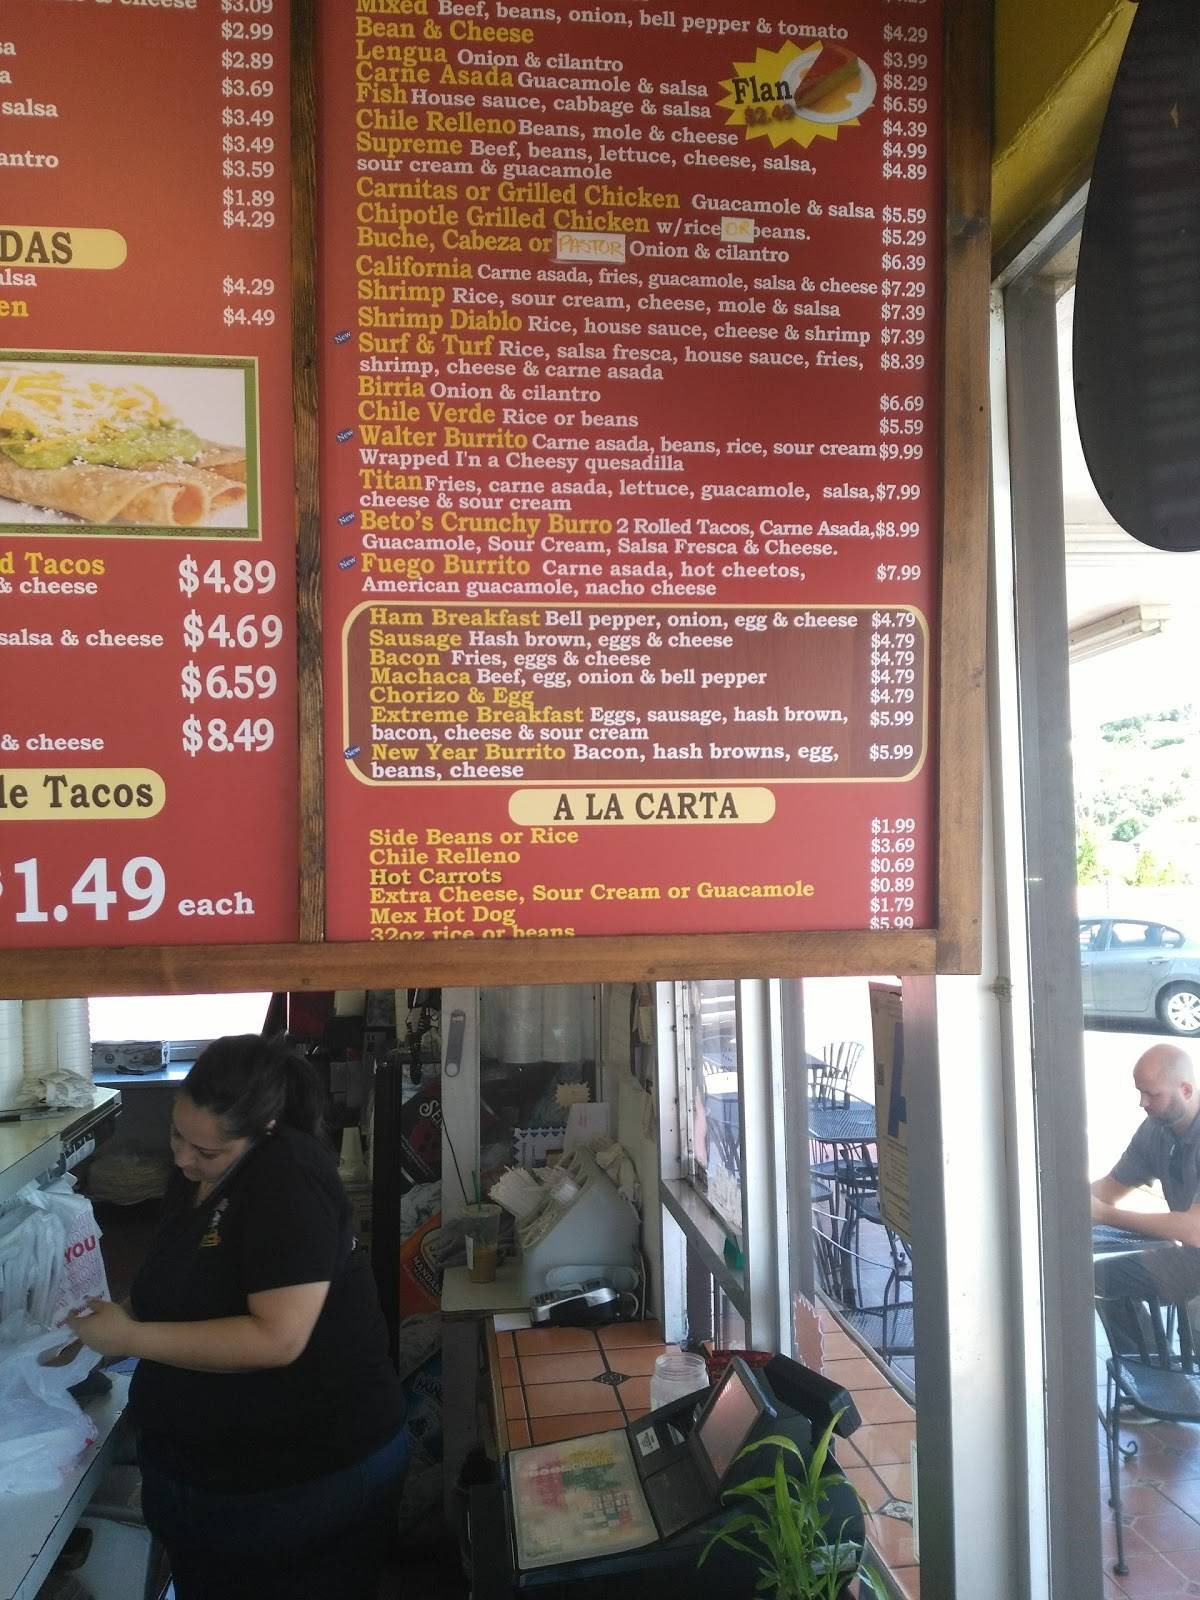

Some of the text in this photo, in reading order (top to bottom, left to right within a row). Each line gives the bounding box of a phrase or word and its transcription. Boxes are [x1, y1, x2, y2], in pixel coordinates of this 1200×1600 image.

[221, 20, 273, 40] $2.99
[355, 16, 534, 43] Bean & Cheese
[221, 49, 273, 70] $2.89
[883, 50, 927, 68] $3.99
[221, 77, 274, 97] $3.69
[732, 77, 792, 104] Flan
[2, 98, 59, 118] salsa
[221, 107, 274, 127] $3.49
[356, 108, 738, 145] Chile Relleno Beans, mole & cheese
[222, 134, 274, 154] $3.49
[882, 140, 927, 159] $4.99
[223, 158, 274, 178] $3.59
[223, 187, 275, 207] $1.89
[356, 177, 875, 219] Carnitas or Grilled Chicken Guacamole & salsa
[223, 208, 275, 229] $4.29
[356, 202, 458, 233] Chipotle
[467, 206, 546, 228] Grilled
[553, 209, 649, 232] Chicken
[656, 218, 721, 237] w/rice
[882, 206, 926, 224] $5.59
[358, 227, 789, 262] Buche, Cabeza or PASTOR Onion & cilantro
[882, 227, 926, 246] $5.29
[881, 252, 926, 271] $6.39
[223, 276, 274, 296] $4.29
[223, 306, 275, 326] $4.49
[358, 376, 601, 402] Birria Onion & cilantro
[880, 393, 924, 412] $6.69
[337, 429, 353, 442] New
[360, 449, 684, 474] Wrapped I'n a Cheesy quesadilla
[338, 512, 355, 525] New
[441, 512, 540, 538] Crunchy
[548, 513, 612, 533] Burro
[616, 519, 629, 533] 2
[634, 518, 691, 534] Rolled
[697, 519, 754, 538] Tacos,
[760, 520, 812, 536] Carne
[817, 521, 875, 539] Asada,
[875, 521, 919, 538] $8.99
[25, 552, 105, 576] Tacos
[339, 556, 357, 569] New
[361, 553, 806, 581] Fuego Burrito Carne asada, hot cheetos,
[877, 563, 921, 581] $7.99
[20, 577, 98, 594] cheese
[179, 554, 276, 598] $4.89
[369, 608, 858, 631] Ham Breakfast Bell pepper, onion, egg & cheese
[871, 611, 915, 629] $4.79
[60, 630, 79, 645] &
[86, 630, 163, 647] cheese
[183, 609, 283, 652] $4.69
[369, 648, 651, 669] Bacon Fries, eggs & cheese
[871, 649, 915, 668] $4.79
[181, 660, 277, 704] $6.59
[369, 687, 534, 708] Chorizo & Egg
[870, 688, 914, 705] $4.79
[1, 734, 104, 750] & cheese
[182, 714, 274, 757] $8.49
[372, 744, 419, 761] New
[426, 744, 478, 760] Year
[485, 743, 566, 760] Burrito
[573, 744, 646, 762] Bacon,
[653, 743, 702, 759] hash
[710, 744, 791, 761] browns,
[798, 747, 839, 762] egg,
[869, 744, 914, 762] $5.99
[372, 762, 523, 781] beans, cheese
[43, 774, 154, 808] Tacos
[553, 791, 739, 820] A LA CARTA
[871, 817, 915, 835] $1.99
[369, 828, 579, 846] Side Beans or Rice
[871, 837, 915, 855] $3.69
[369, 848, 520, 865] Chile Relleno
[870, 857, 914, 874] $0.69
[369, 868, 502, 885] Hot Carrots
[870, 877, 914, 894] $0.89
[370, 880, 815, 904] Extra Cheese, Sour Cream or Guacamole
[178, 892, 254, 916] each
[870, 897, 914, 914] $1.79
[370, 906, 516, 926] Mex Hot Dog
[64, 1234, 97, 1264] YOU
